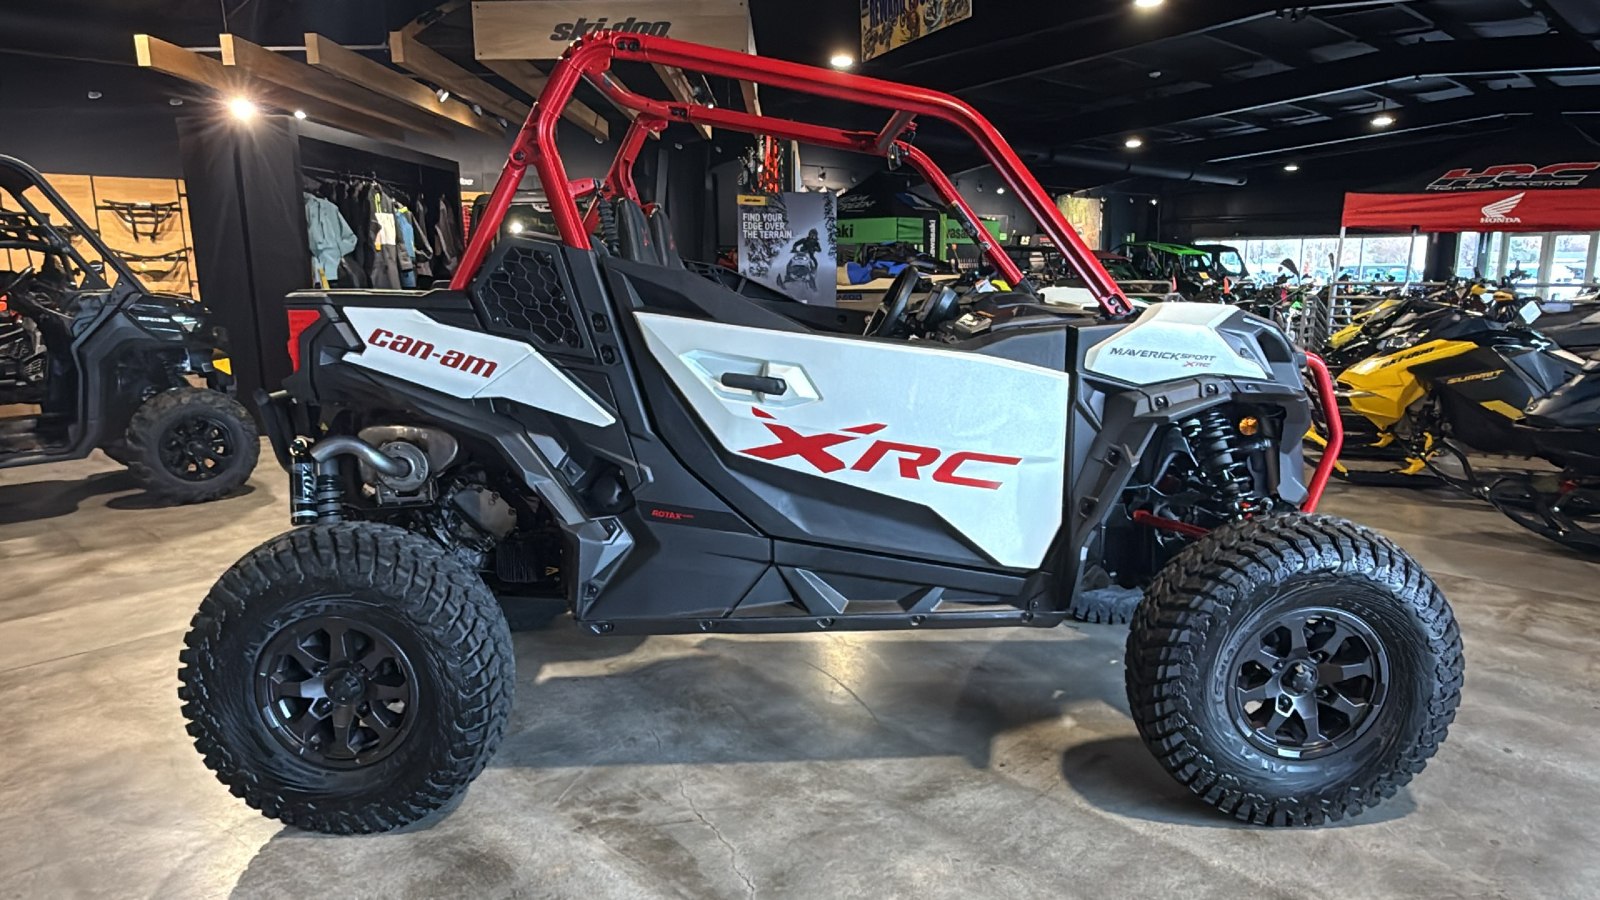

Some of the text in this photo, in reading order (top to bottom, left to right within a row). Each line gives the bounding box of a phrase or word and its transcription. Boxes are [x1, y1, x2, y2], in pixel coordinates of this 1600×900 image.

[1428, 162, 1600, 187] HRC
[743, 213, 783, 221] FIND YOUR
[743, 222, 785, 230] EDGE OVER
[743, 231, 758, 239] THE
[368, 328, 498, 378] can-am
[1109, 347, 1216, 361] MAVERICK SPORT
[736, 406, 1023, 490] XRC
[302, 463, 317, 502] FOX
[652, 509, 682, 520] ROTAX
